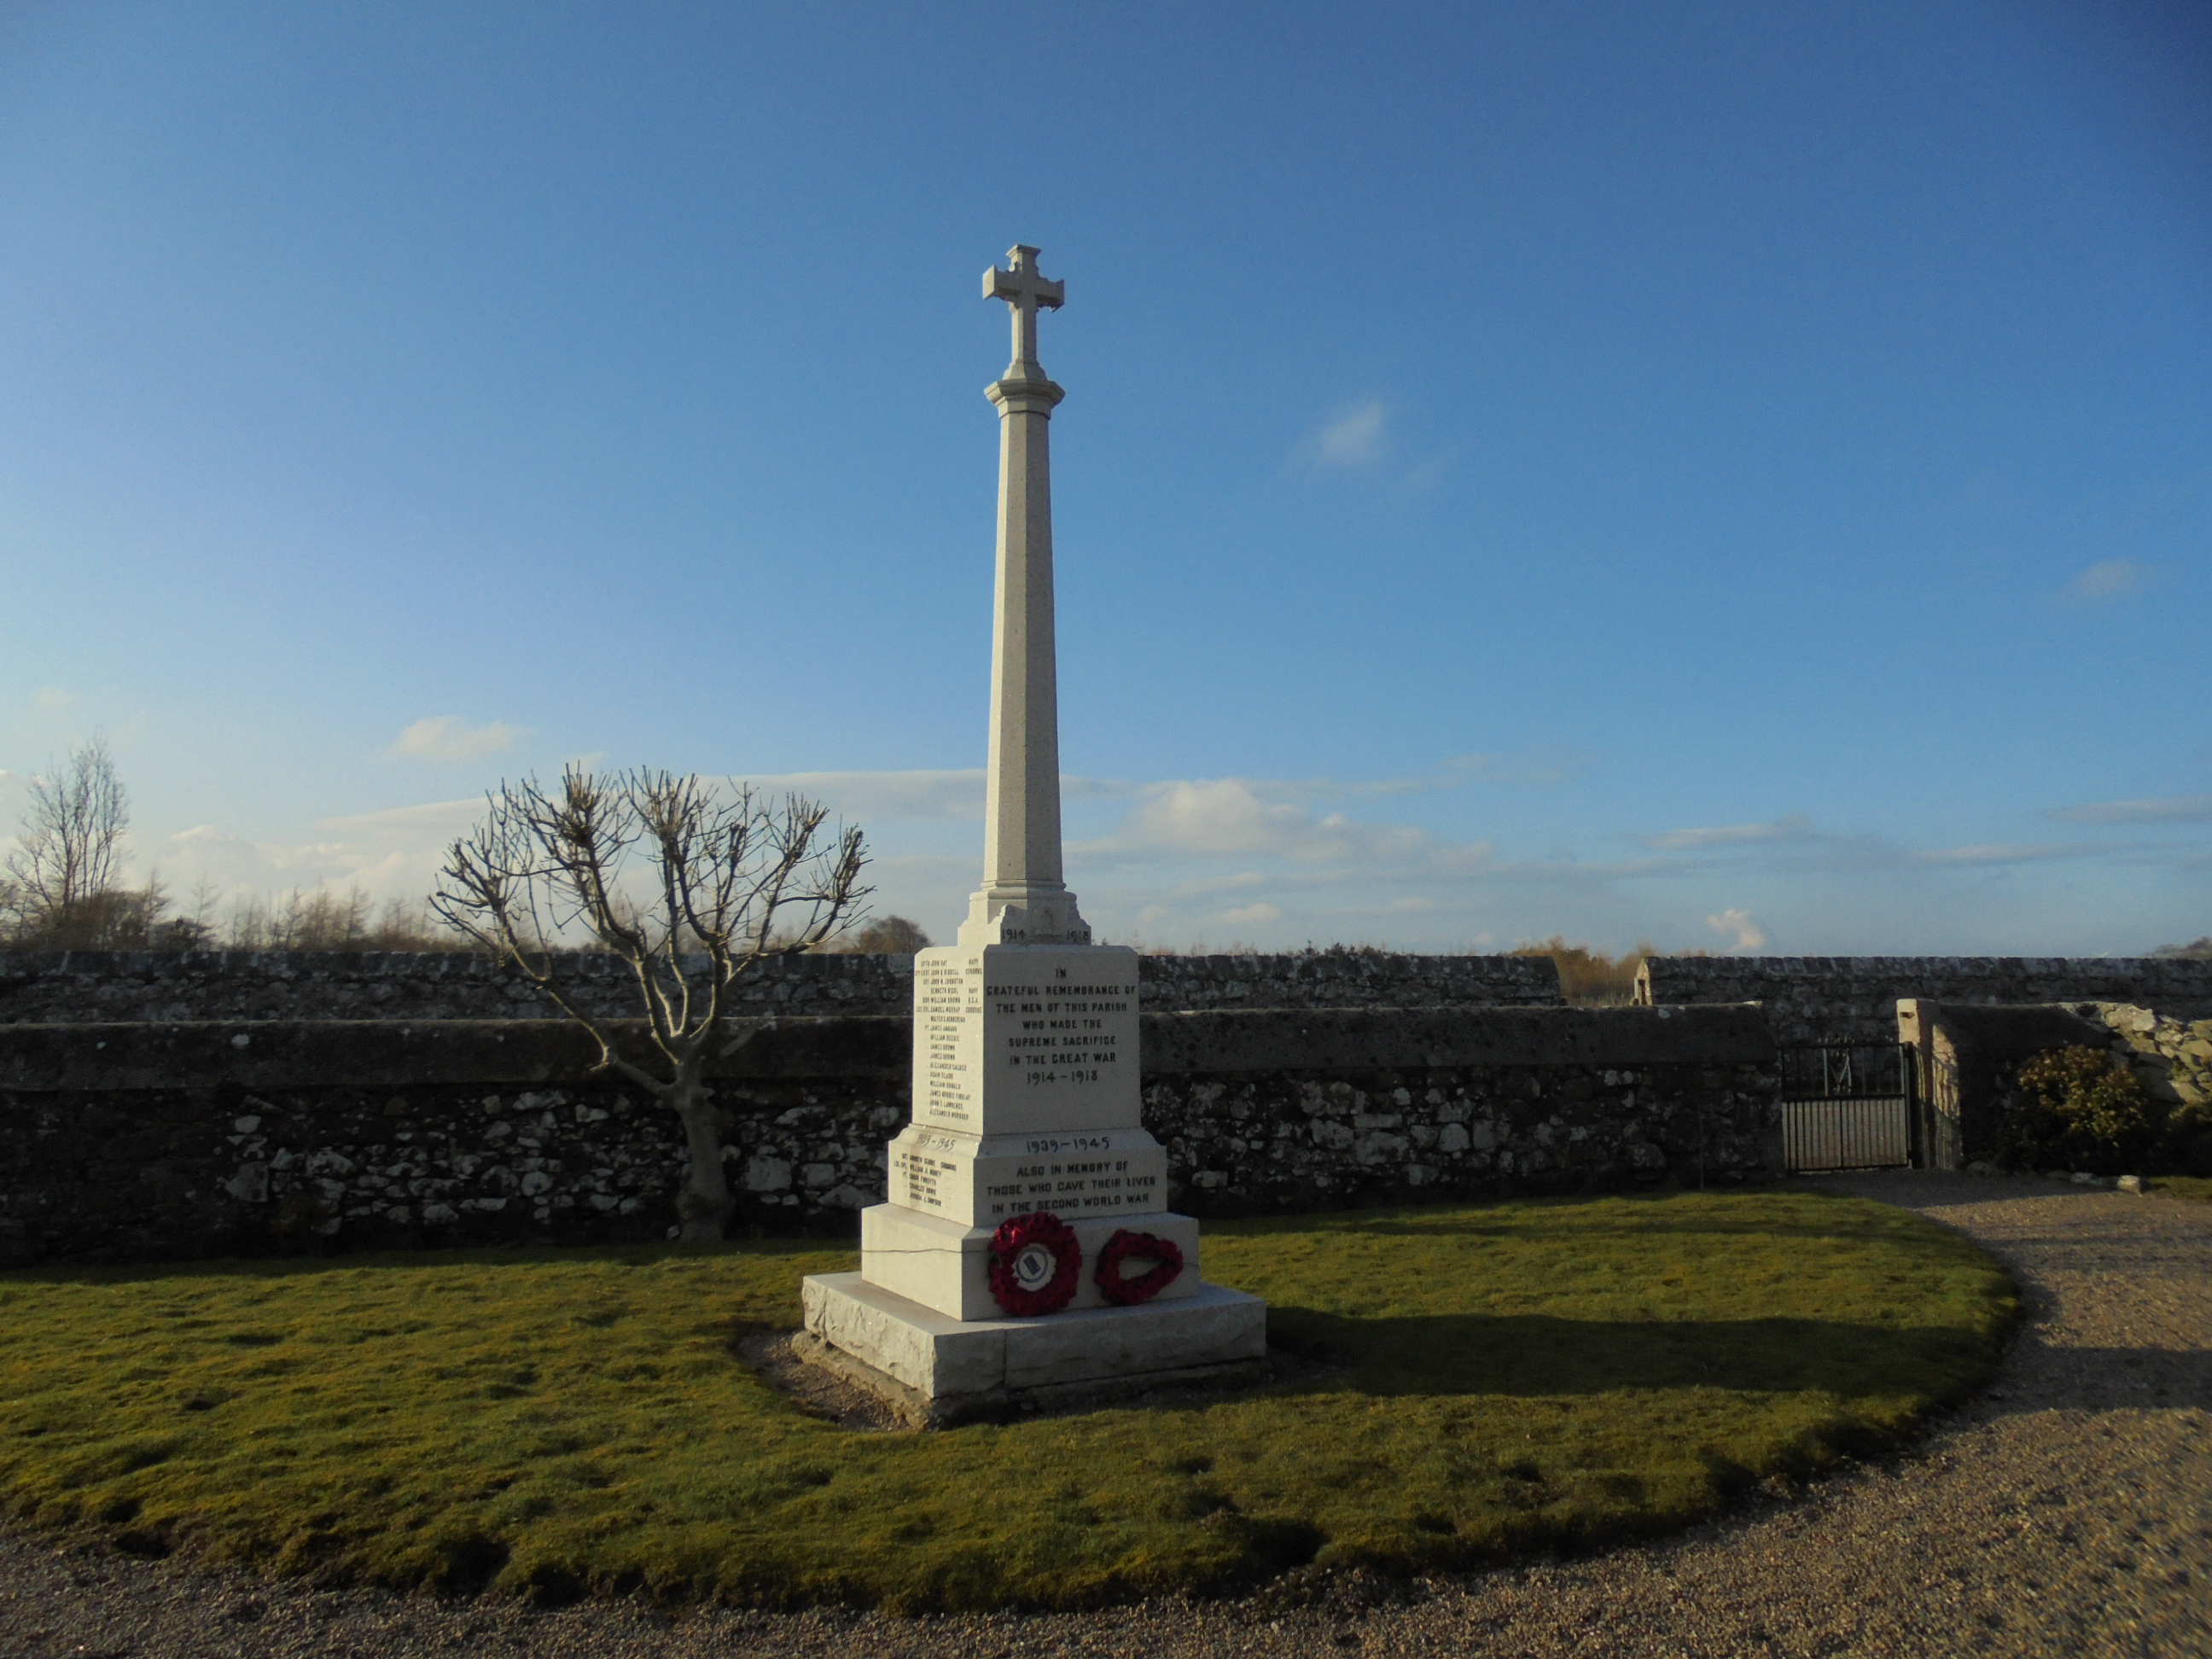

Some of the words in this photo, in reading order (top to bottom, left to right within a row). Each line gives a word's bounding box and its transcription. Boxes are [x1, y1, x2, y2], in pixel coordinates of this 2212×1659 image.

[1002, 929, 1026, 942] 1914
[1056, 968, 1066, 978] IN
[987, 986, 1039, 995] GRATEFUL
[1046, 986, 1119, 995] REMEMBRANCE
[1125, 986, 1136, 995] OF
[996, 1003, 1015, 1013] THE
[1021, 1003, 1041, 1012] MEN
[1048, 1003, 1059, 1012] OF
[1066, 1003, 1087, 1012] THIS
[1092, 1002, 1127, 1011] PARISH
[1023, 1020, 1044, 1029] WHO
[1051, 1020, 1077, 1029] MADE
[1083, 1020, 1102, 1028] THE
[1009, 1037, 1056, 1046] SUPREME
[1062, 1036, 1116, 1045] SACRIFICE
[1010, 1055, 1020, 1065] IN
[1026, 1055, 1046, 1064] THE
[1052, 1053, 1088, 1063] GREAT
[1094, 1052, 1116, 1062] WAR
[1017, 1166, 1044, 1176] ALSO
[1051, 1165, 1061, 1174] IN
[1067, 1162, 1110, 1173] MEMORY
[1116, 1161, 1128, 1172] OF
[987, 1185, 1022, 1195] THOSE
[1029, 1183, 1051, 1193] WHO
[1058, 1181, 1084, 1191] GAVE
[1092, 1179, 1120, 1189] THEIR
[1127, 1176, 1155, 1186] LIVES
[992, 1204, 1003, 1213] IN
[1011, 1201, 1031, 1212] THE
[1038, 1198, 1079, 1210] SECOND
[1084, 1195, 1120, 1206] WORLD
[1127, 1194, 1149, 1203] WAR
